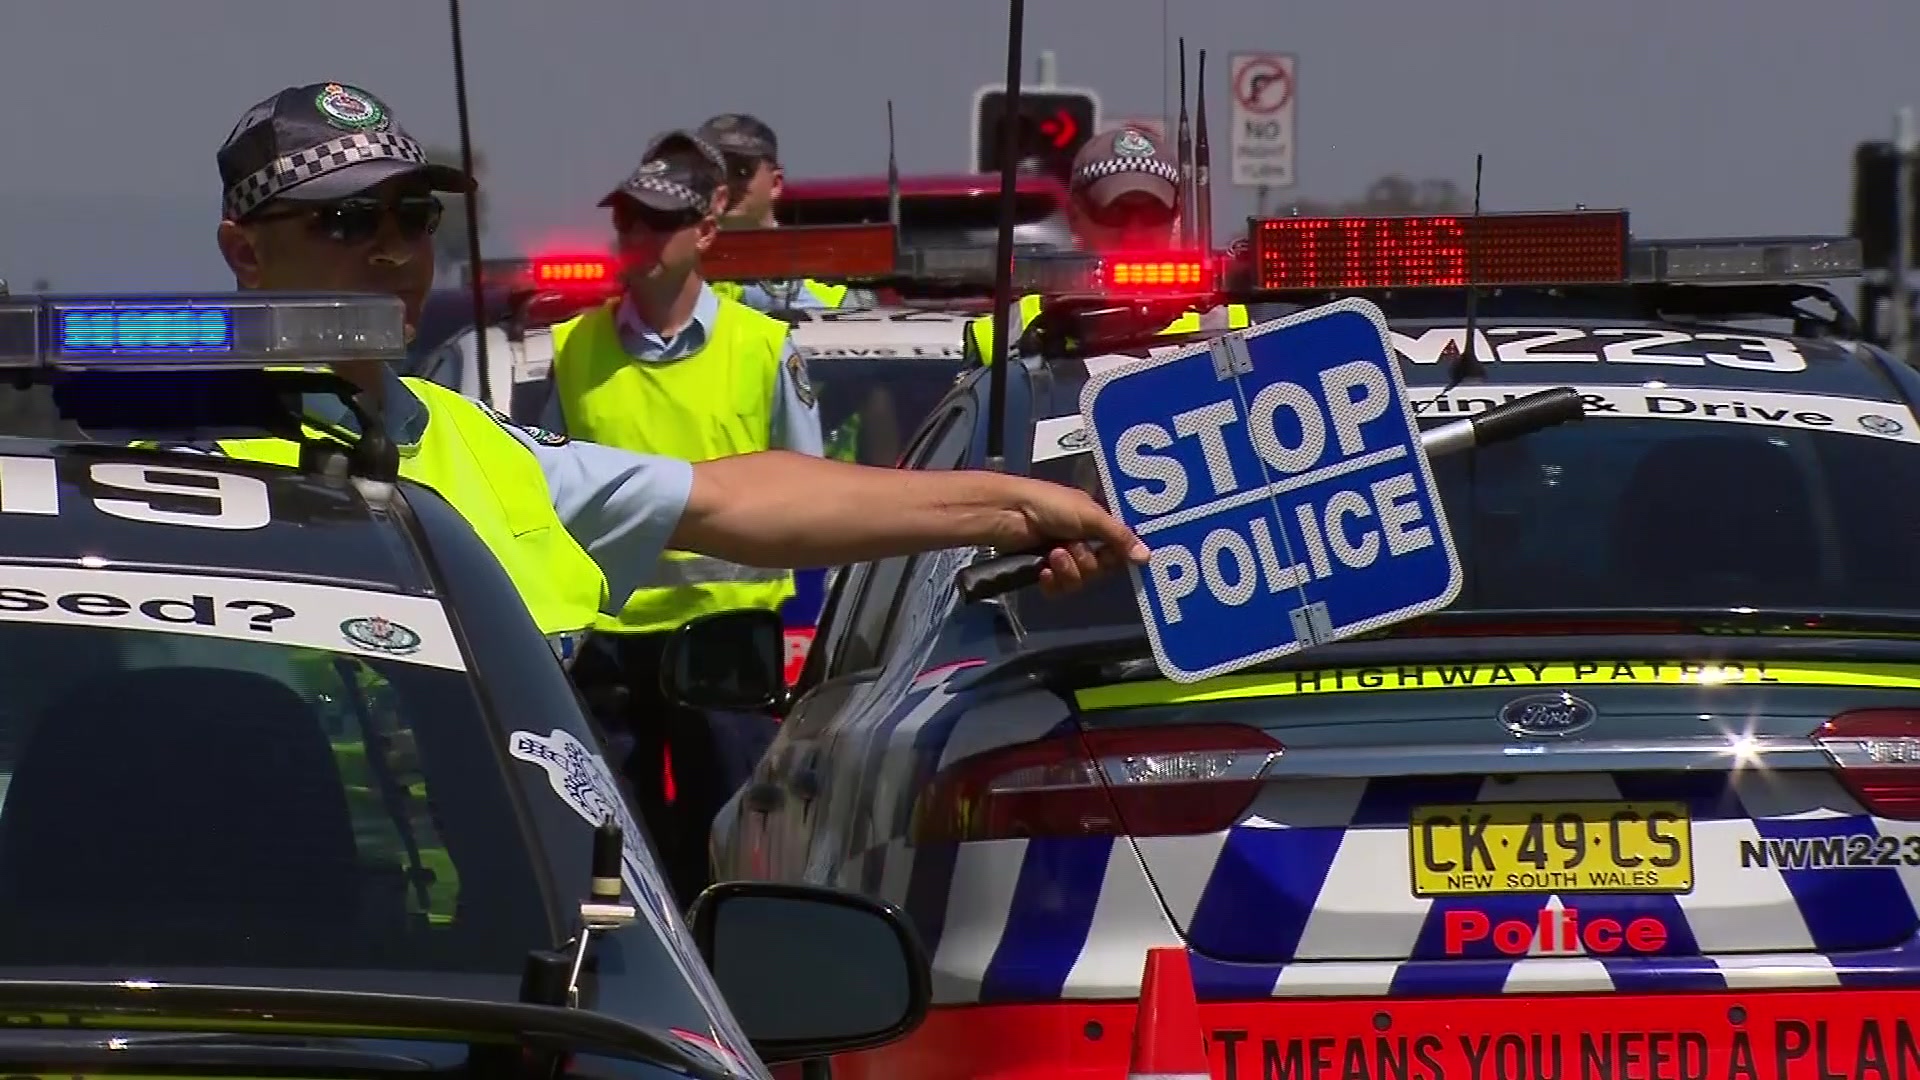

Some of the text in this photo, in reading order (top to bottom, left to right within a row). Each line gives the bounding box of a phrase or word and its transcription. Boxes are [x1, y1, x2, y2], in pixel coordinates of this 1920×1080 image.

[1644, 396, 1834, 426] Drive
[1114, 359, 1392, 517] STOP
[1149, 472, 1435, 625] POLICE
[1295, 662, 1548, 692] HIGHWAY
[1521, 703, 1576, 725] Ford
[1740, 835, 1920, 868] NWM223
[1447, 870, 1659, 890] NEW SOUTH WALES
[1444, 907, 1668, 956] Police
[1262, 1034, 1445, 1080] MEANS
[1459, 1033, 1563, 1080] YOU
[1580, 1030, 1708, 1080] NEED
[1728, 1028, 1760, 1080] A
